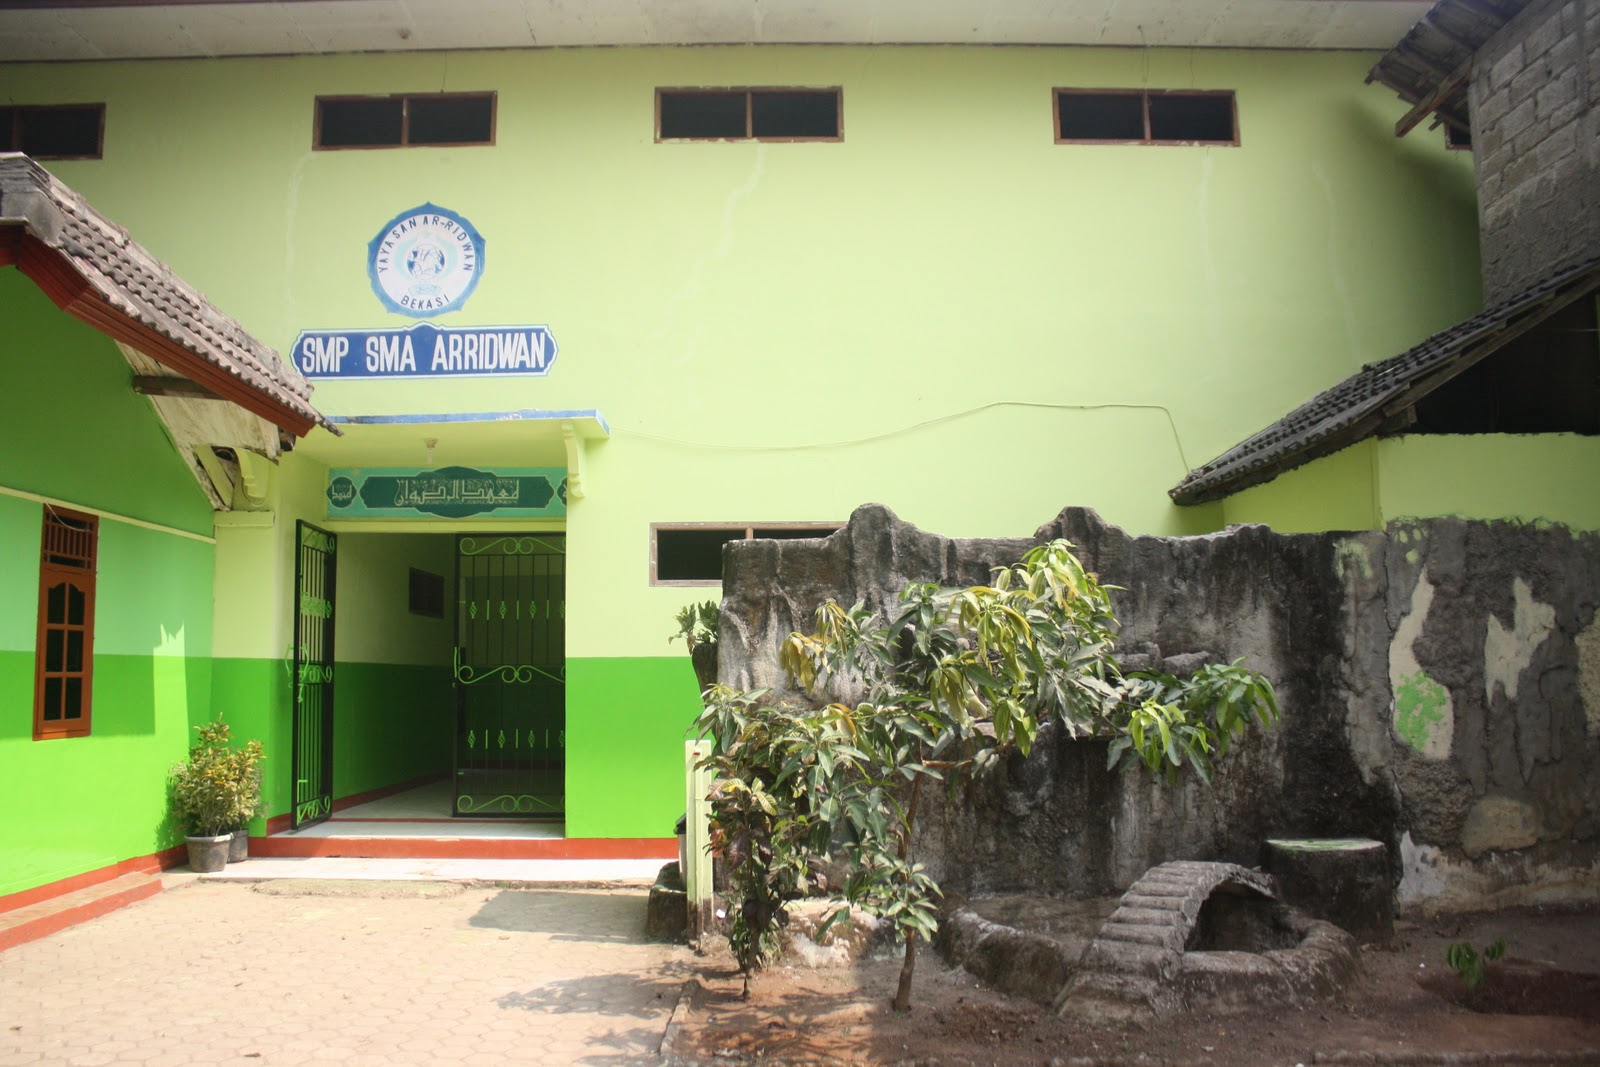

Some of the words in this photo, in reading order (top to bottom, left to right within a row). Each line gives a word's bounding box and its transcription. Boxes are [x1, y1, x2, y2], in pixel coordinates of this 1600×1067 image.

[379, 217, 417, 273] YAYASAN
[423, 215, 473, 271] AR-RIDWAN
[401, 293, 450, 310] BEKASI
[302, 336, 349, 373] SMP
[366, 334, 416, 372] SMA
[431, 331, 546, 371] ARRIDWAN
